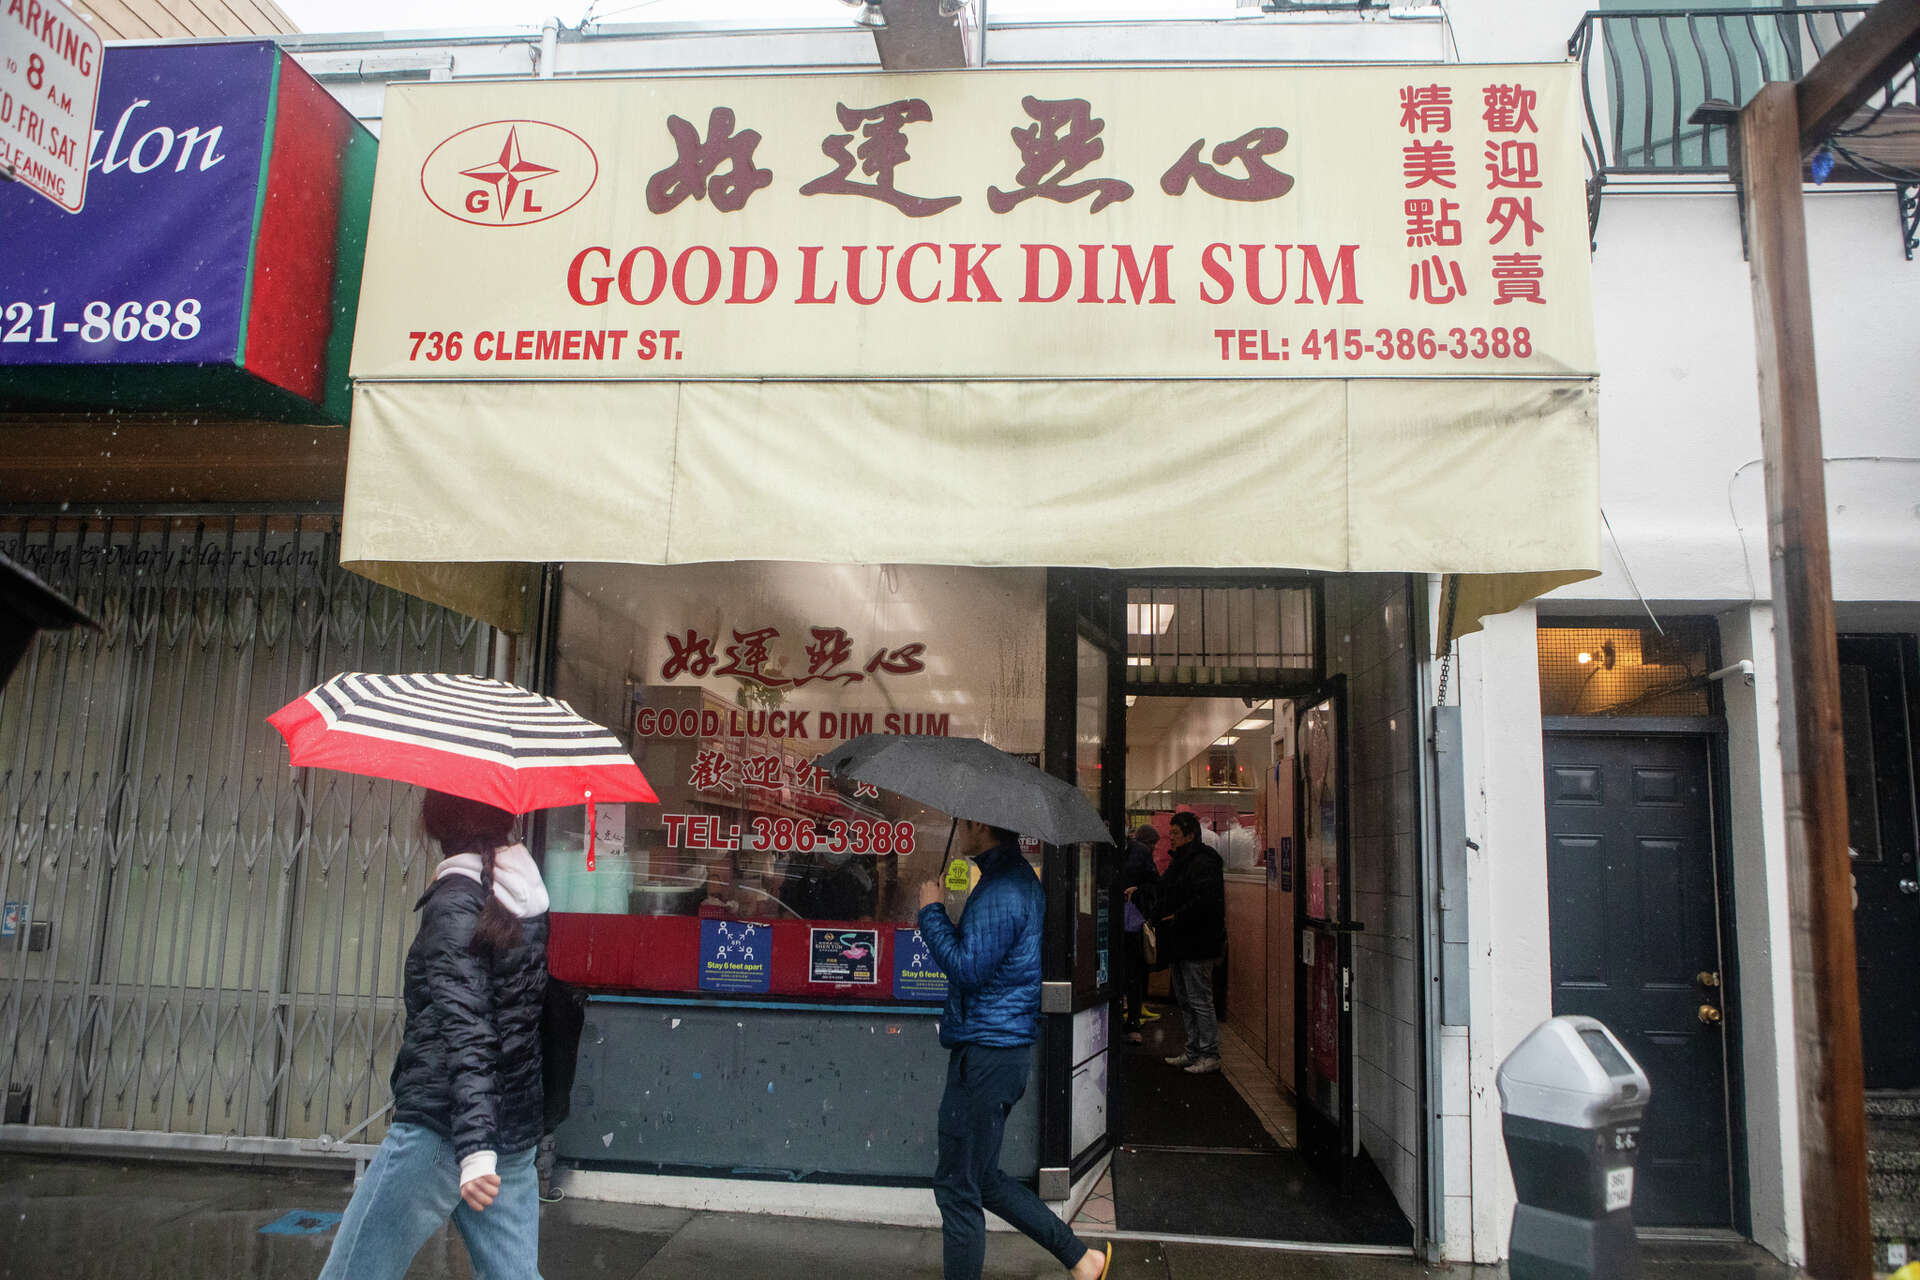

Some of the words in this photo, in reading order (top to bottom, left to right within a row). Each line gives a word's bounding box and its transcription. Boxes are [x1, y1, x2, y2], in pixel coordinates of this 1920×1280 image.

[0, 0, 93, 77] ARKING
[27, 53, 44, 90] 8
[465, 189, 490, 214] G
[522, 189, 543, 213] L
[1400, 83, 1467, 305] 精美點心
[1482, 83, 1547, 306] 歡迎外賣
[567, 246, 779, 306] GOOD
[794, 242, 1003, 306] LUCK
[1018, 243, 1176, 305] DIM
[1199, 242, 1364, 306] SUM
[409, 331, 463, 362] 736
[473, 330, 628, 361] CLEMENT
[637, 330, 683, 360] ST.
[1213, 329, 1290, 361] TEL:
[1301, 327, 1533, 361] 415-386-3388
[179, 541, 243, 566] Har
[636, 708, 720, 737] GOOD
[730, 710, 809, 739] LUCK
[818, 711, 874, 740] DIM
[883, 712, 950, 737] SUM
[688, 750, 880, 799] 歡迎外
[662, 813, 741, 850] TEL:
[751, 818, 916, 856] 386-3388
[707, 961, 723, 970] Stay
[901, 969, 918, 978] Stay
[925, 970, 939, 978] feet
